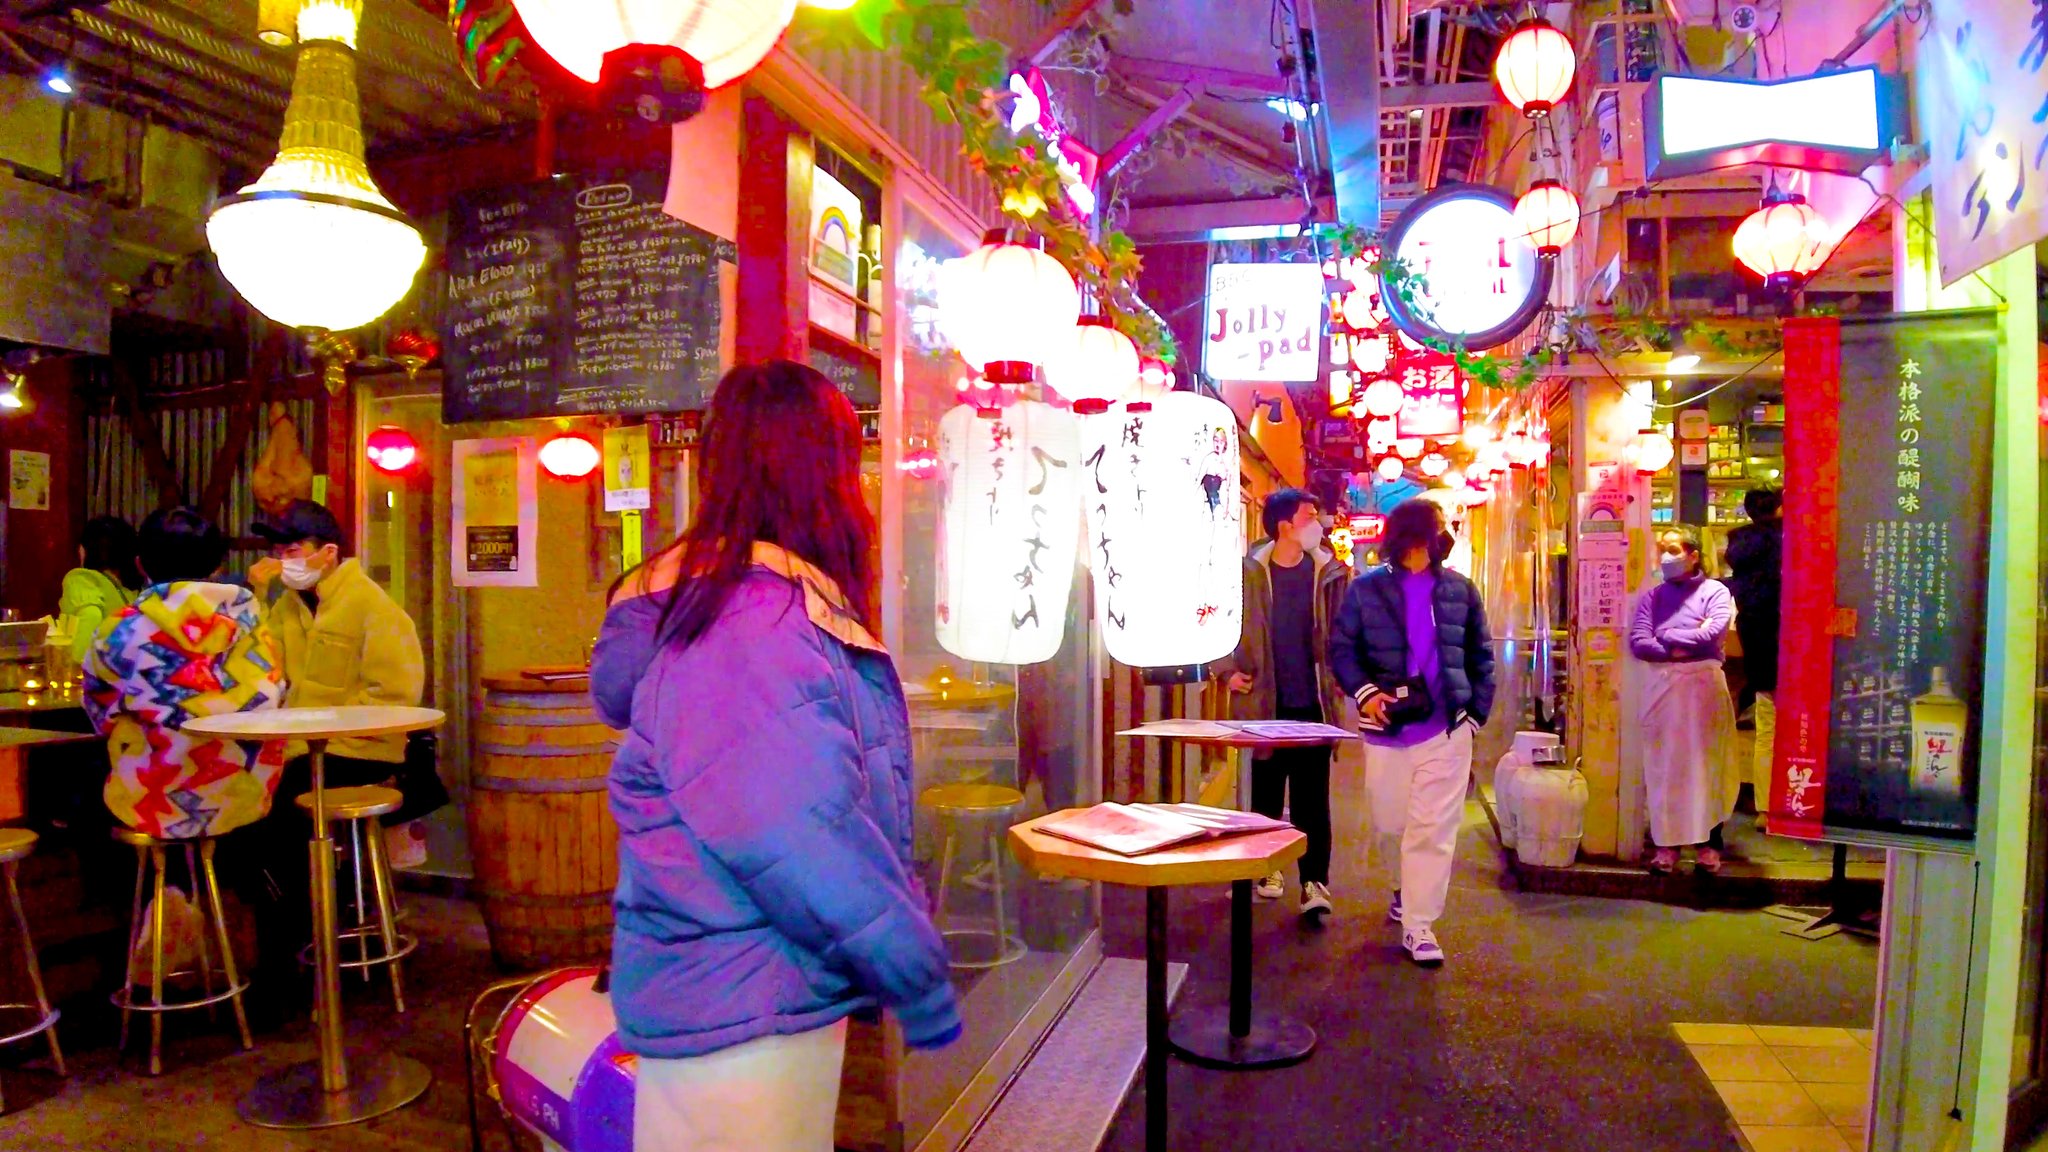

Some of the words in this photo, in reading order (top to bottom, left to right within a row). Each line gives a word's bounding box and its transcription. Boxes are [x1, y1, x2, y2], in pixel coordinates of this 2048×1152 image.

[1210, 304, 1287, 343] Jolly
[1401, 364, 1455, 391] お酒
[1898, 357, 1923, 513] 本格派の醍醐味
